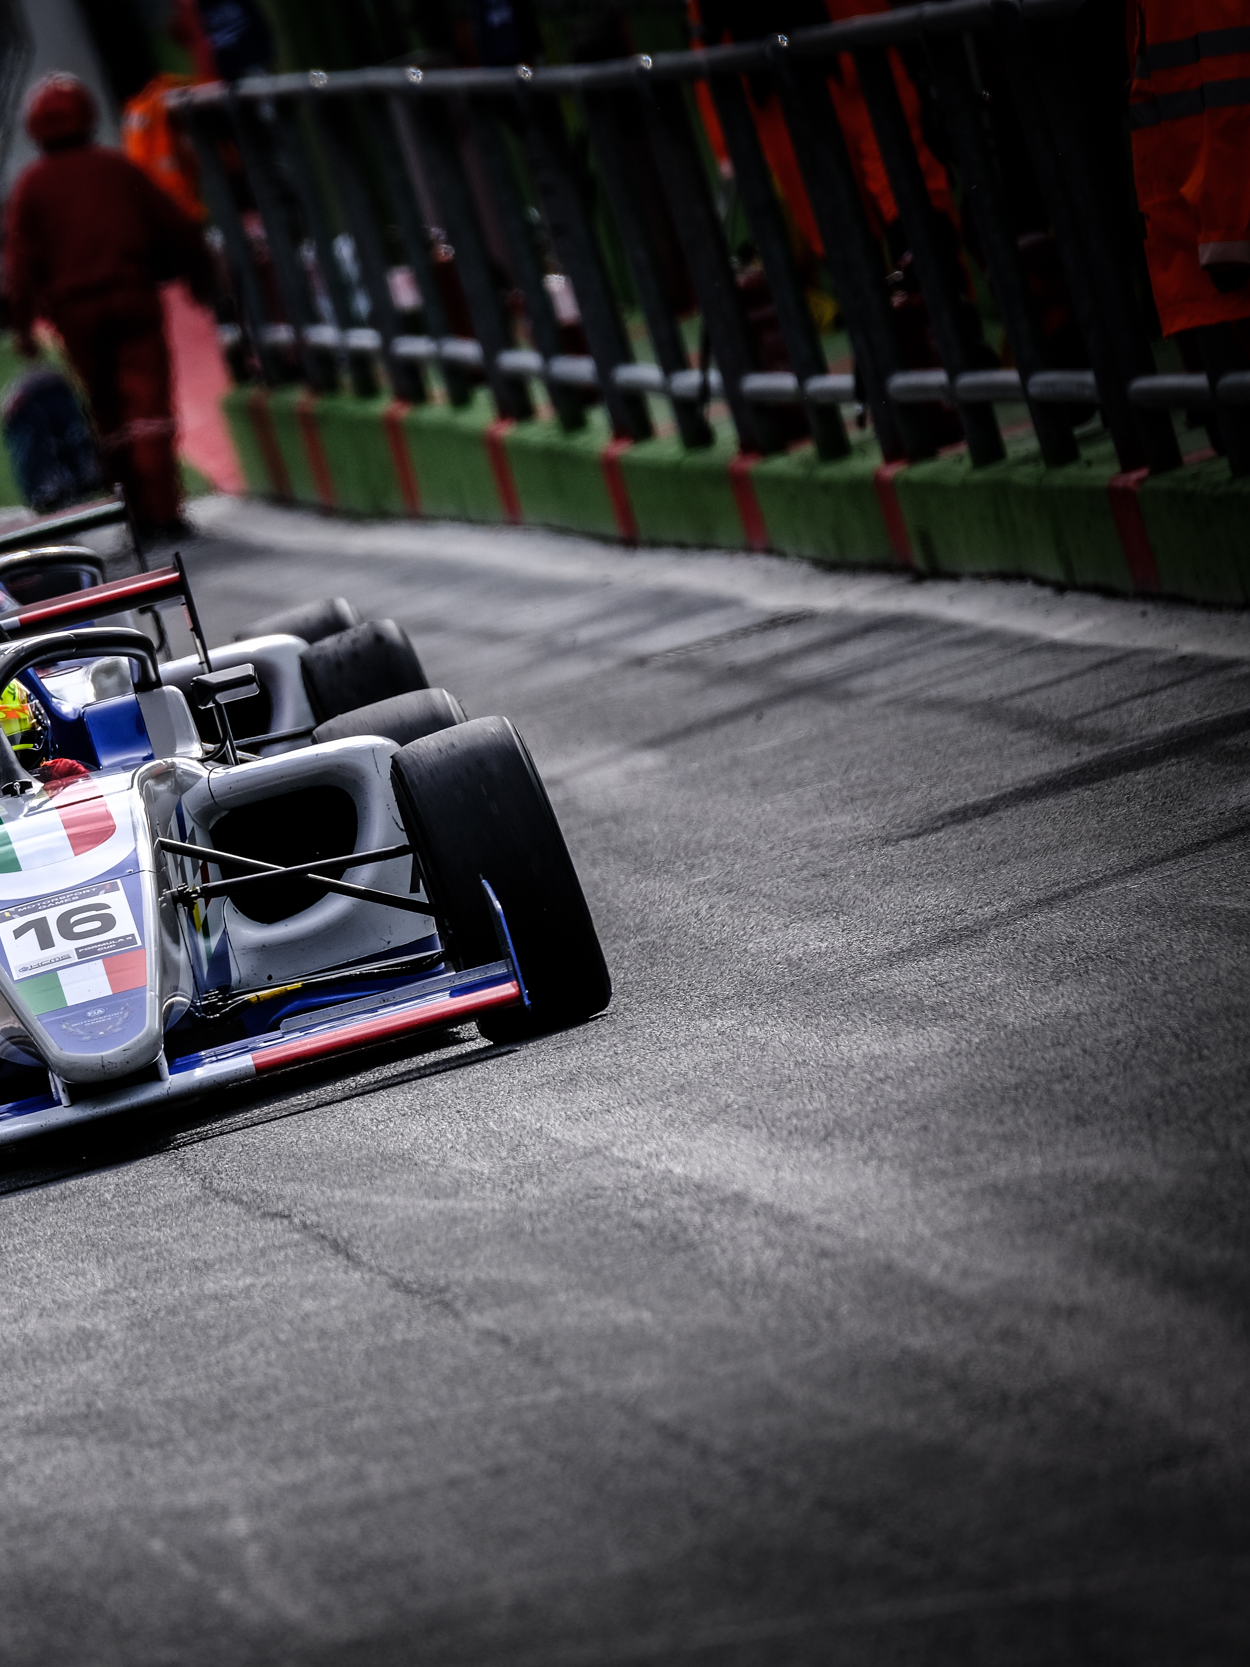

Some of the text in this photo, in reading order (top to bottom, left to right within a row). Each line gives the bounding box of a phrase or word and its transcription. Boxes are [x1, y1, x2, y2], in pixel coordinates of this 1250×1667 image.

[17, 887, 98, 912] MOTORSPORT
[38, 896, 79, 909] GAMES
[12, 902, 117, 951] 16
[78, 938, 124, 952] FORMULA
[97, 943, 116, 952] CUP
[71, 1011, 123, 1027] MOTORSPORT
[87, 1008, 105, 1017] FIA
